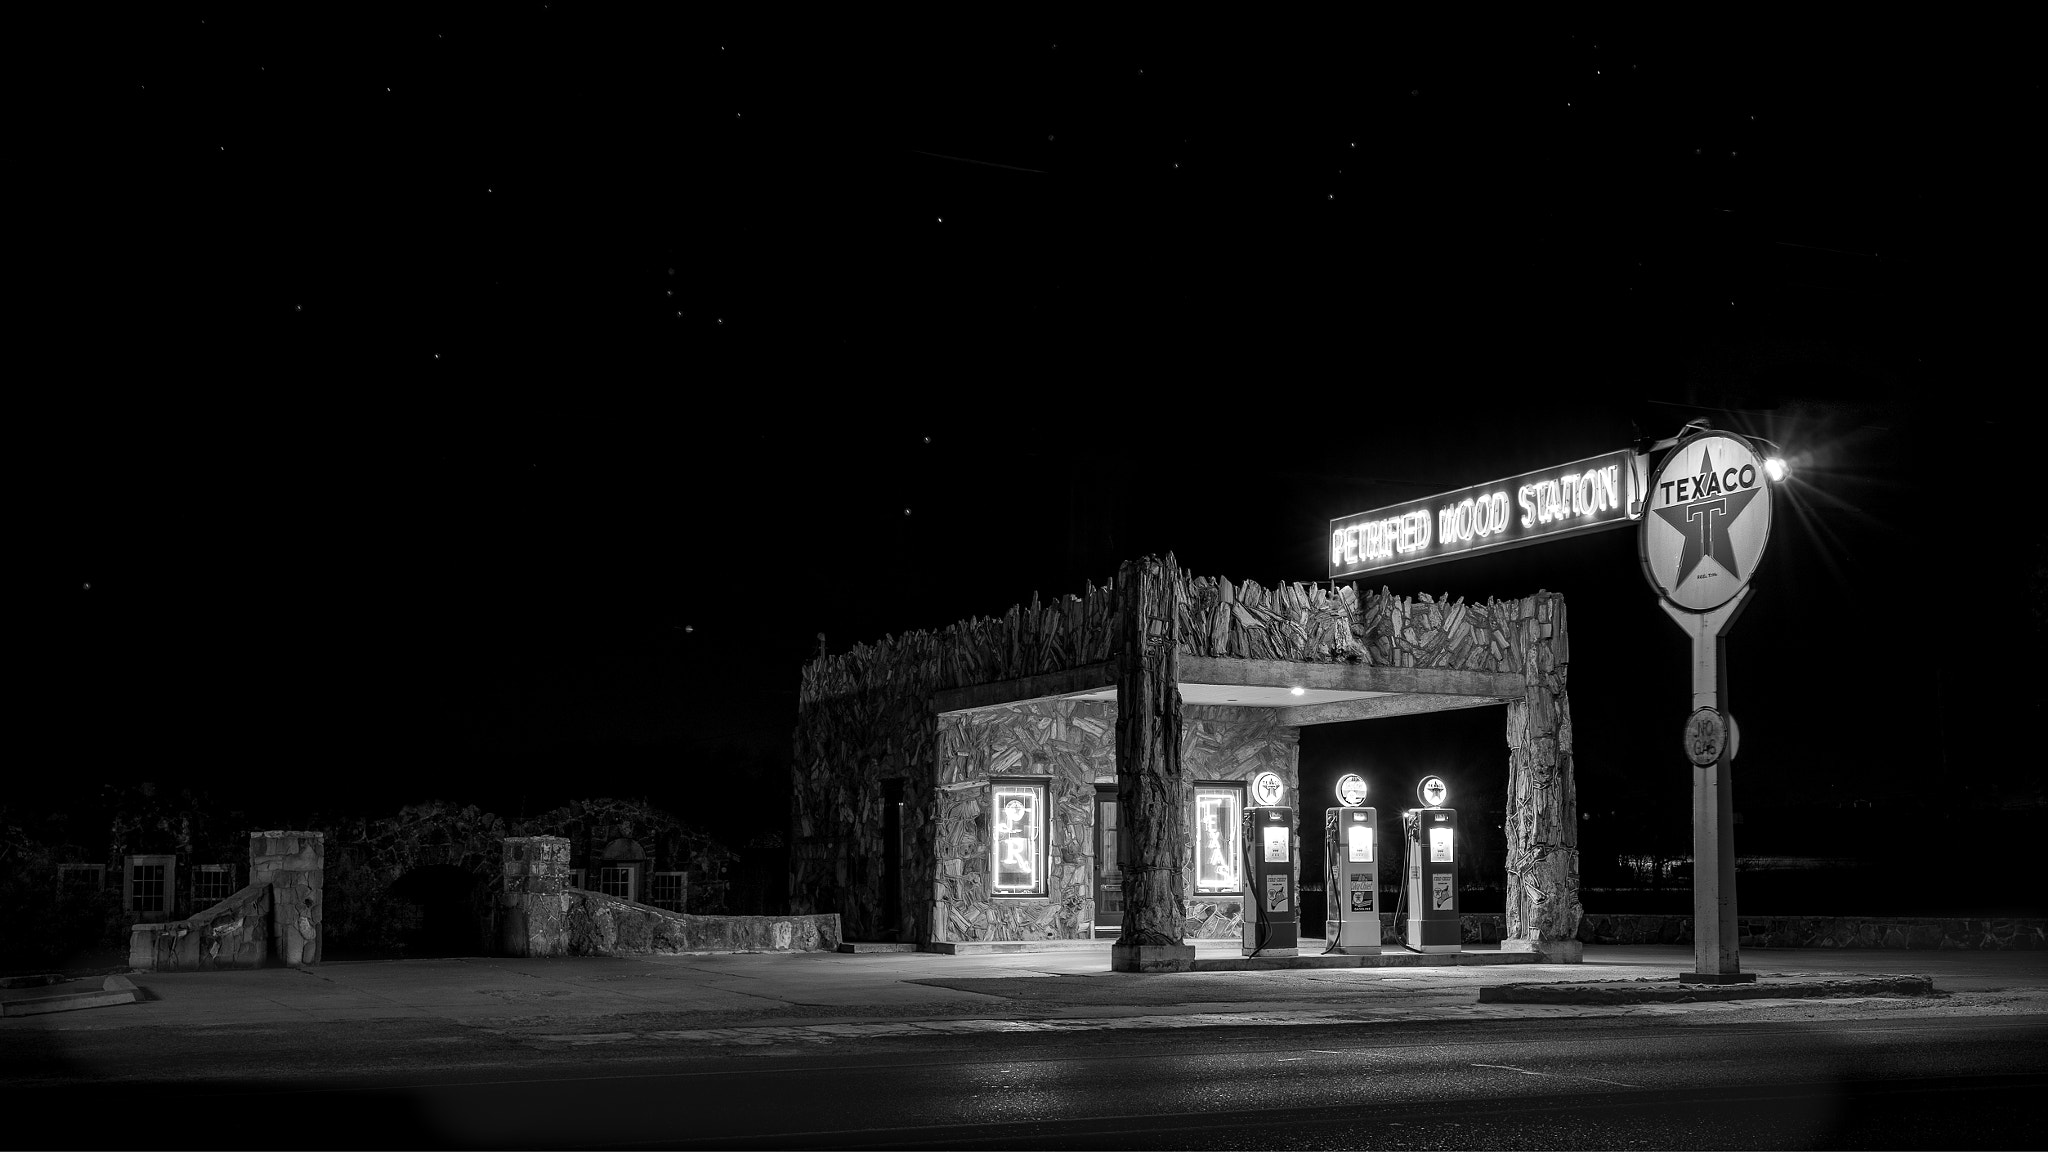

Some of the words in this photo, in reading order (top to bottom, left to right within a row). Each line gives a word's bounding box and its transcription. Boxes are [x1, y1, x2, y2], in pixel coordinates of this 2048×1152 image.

[1660, 463, 1756, 504] TEXACO
[1332, 509, 1431, 566] PETRIFIED
[1439, 491, 1509, 544] WOOD
[1518, 465, 1618, 528] STATION
[1686, 498, 1727, 557] T
